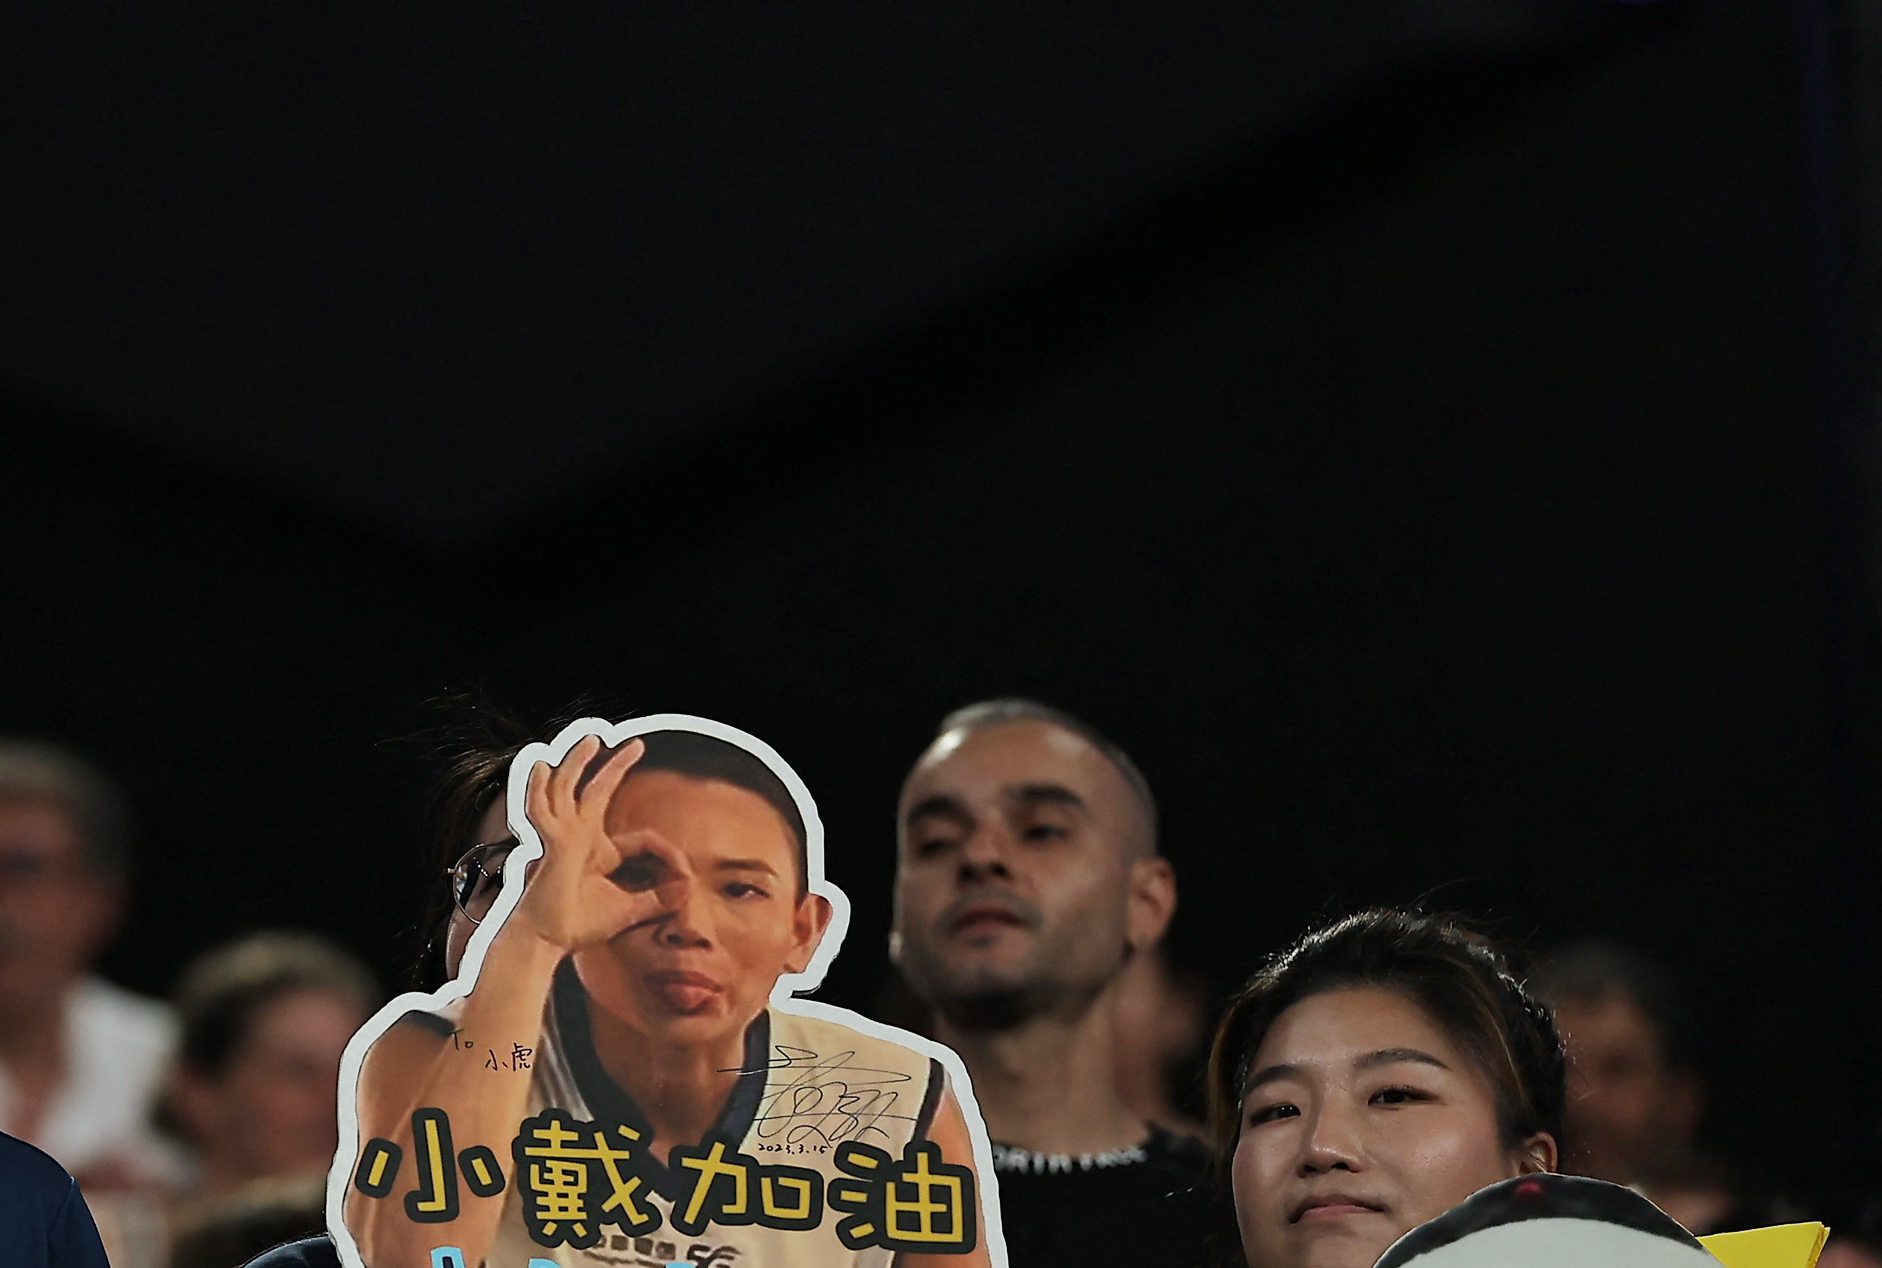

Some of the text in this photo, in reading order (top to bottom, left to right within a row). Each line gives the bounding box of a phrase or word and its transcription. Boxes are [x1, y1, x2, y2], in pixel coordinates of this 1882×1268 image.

[448, 1028, 474, 1052] To
[357, 1108, 975, 1254] 小戴加油
